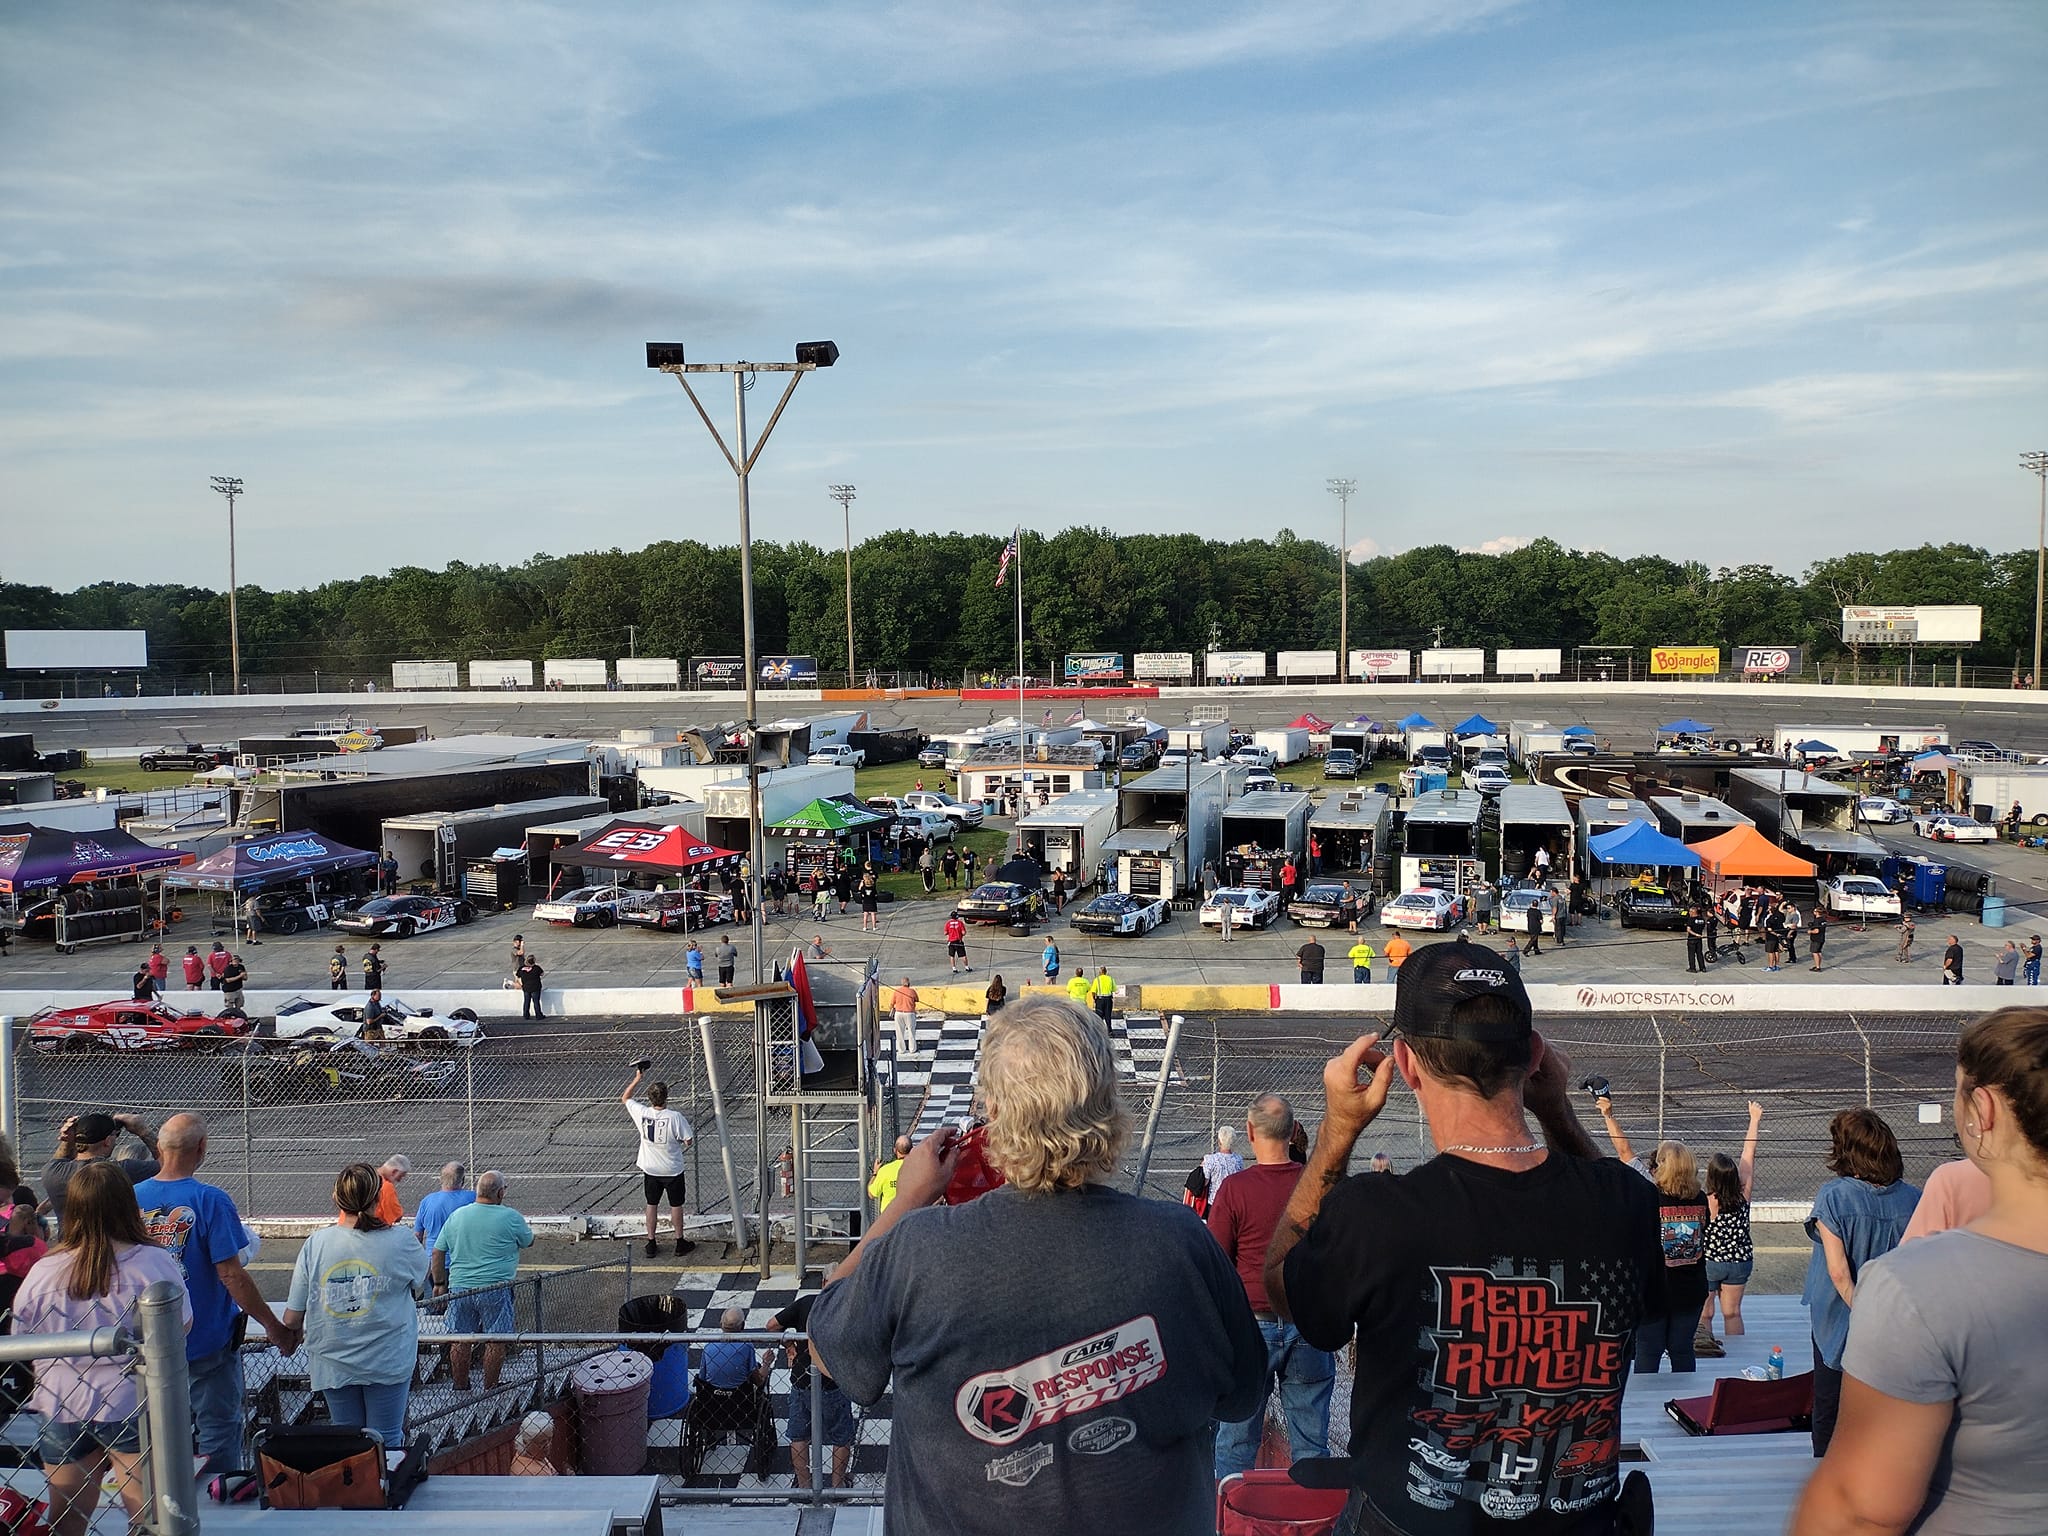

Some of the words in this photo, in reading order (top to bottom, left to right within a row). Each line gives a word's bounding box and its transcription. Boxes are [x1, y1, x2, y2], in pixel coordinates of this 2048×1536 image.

[1655, 652, 1716, 670] Bojangles
[338, 737, 374, 746] SUNOCO
[707, 903, 719, 920] 5
[1601, 992, 1735, 1006] MOTORSTATS.COM
[106, 1027, 148, 1049] 12
[1448, 1276, 1547, 1333] RED
[1487, 1310, 1588, 1358] DIRT
[1061, 1332, 1118, 1367] CARS
[1032, 1338, 1150, 1401] RESPONSE
[1445, 1341, 1622, 1395] RUMBLE
[1037, 1363, 1161, 1426] TOUR
[1557, 1439, 1613, 1468] 31
[1488, 1494, 1538, 1504] WEATHERMAN
